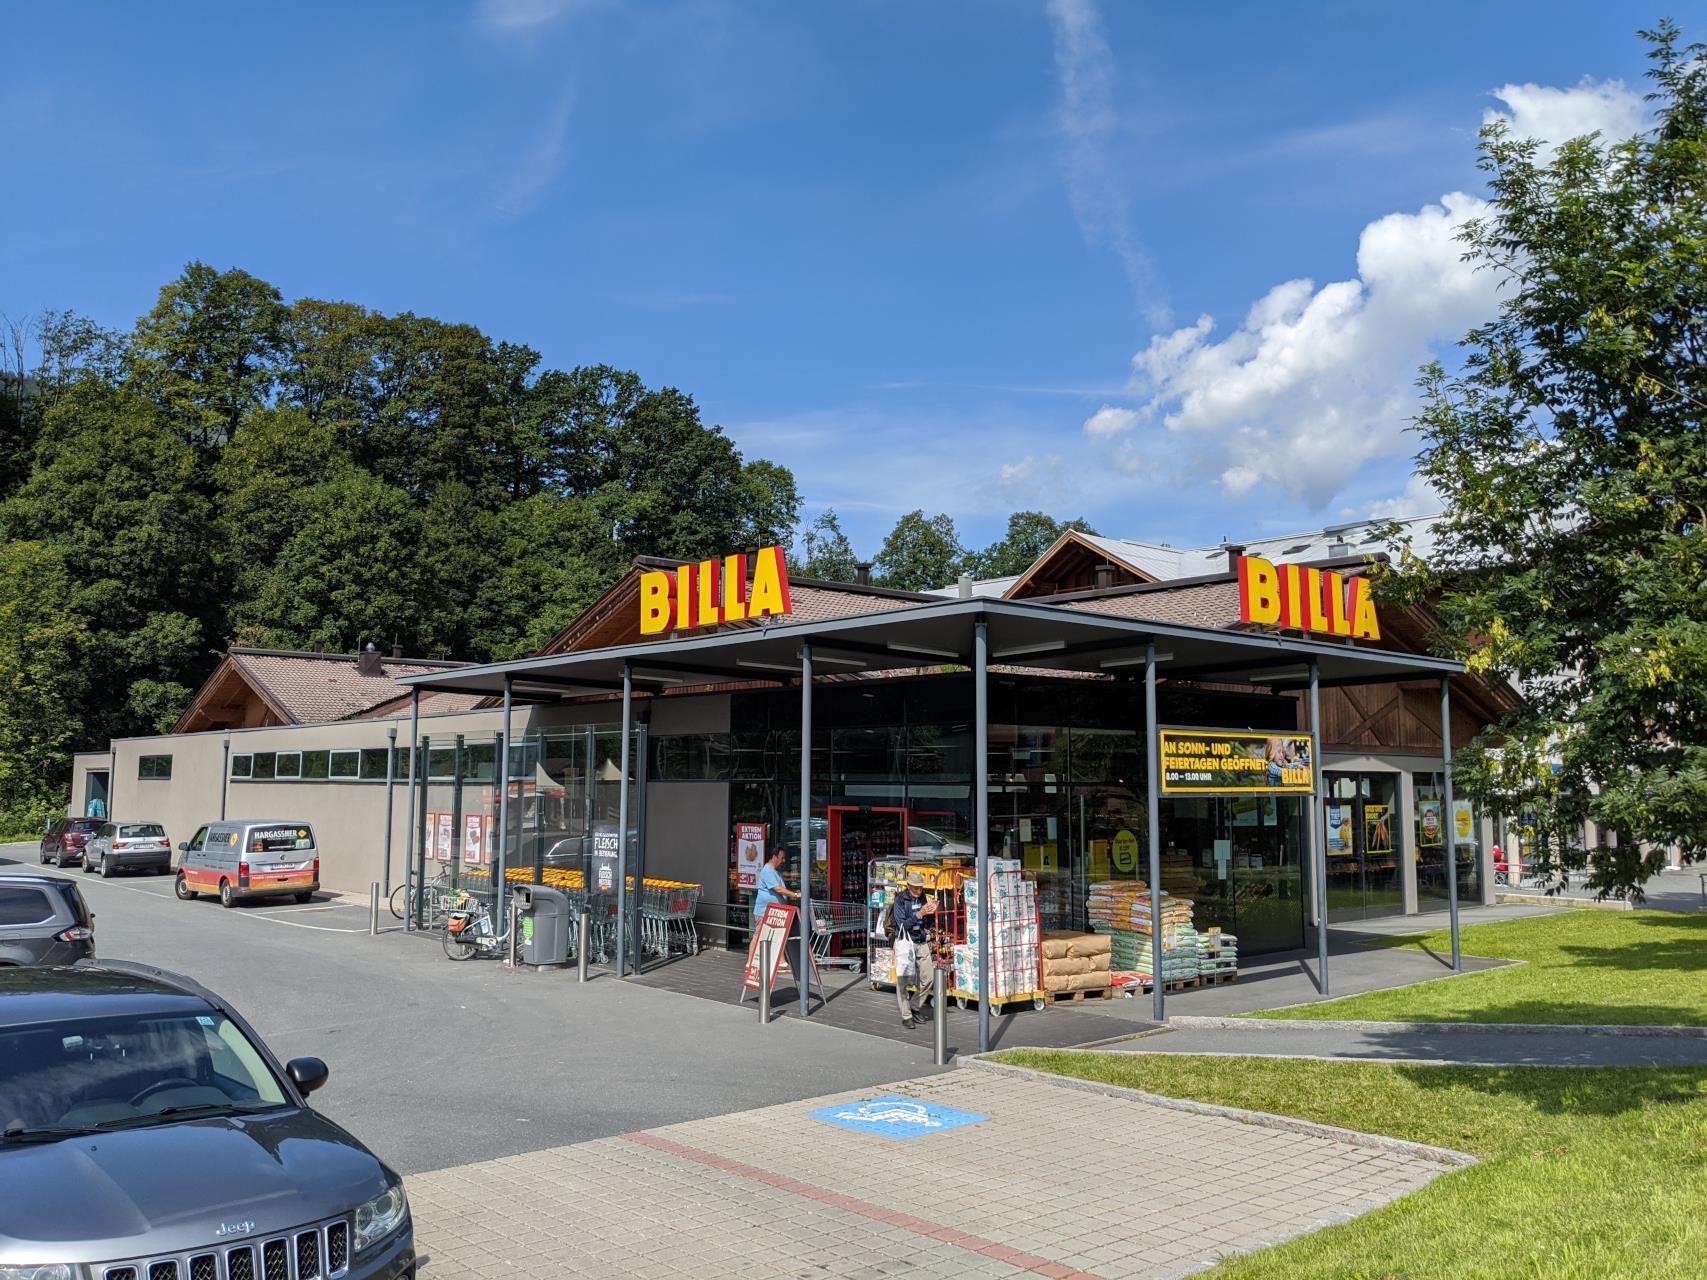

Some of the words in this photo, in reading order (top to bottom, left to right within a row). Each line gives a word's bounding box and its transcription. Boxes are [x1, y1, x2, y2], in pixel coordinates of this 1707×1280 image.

[640, 546, 790, 635] BILLA
[1239, 556, 1381, 640] BILLA
[1164, 741, 1177, 754] AN
[1178, 742, 1210, 754] SONN-
[1212, 743, 1231, 755] UND
[1164, 756, 1219, 770] FEIERTAGEN
[1185, 772, 1199, 780] 13.00
[1200, 772, 1212, 781] UHR
[1281, 768, 1309, 784] BILLA
[254, 829, 297, 840] HARGASSNER
[594, 837, 618, 850] FLEISCH
[768, 907, 789, 919] EXTREM
[766, 916, 786, 927] AKTION
[215, 1221, 256, 1236] Jeep
